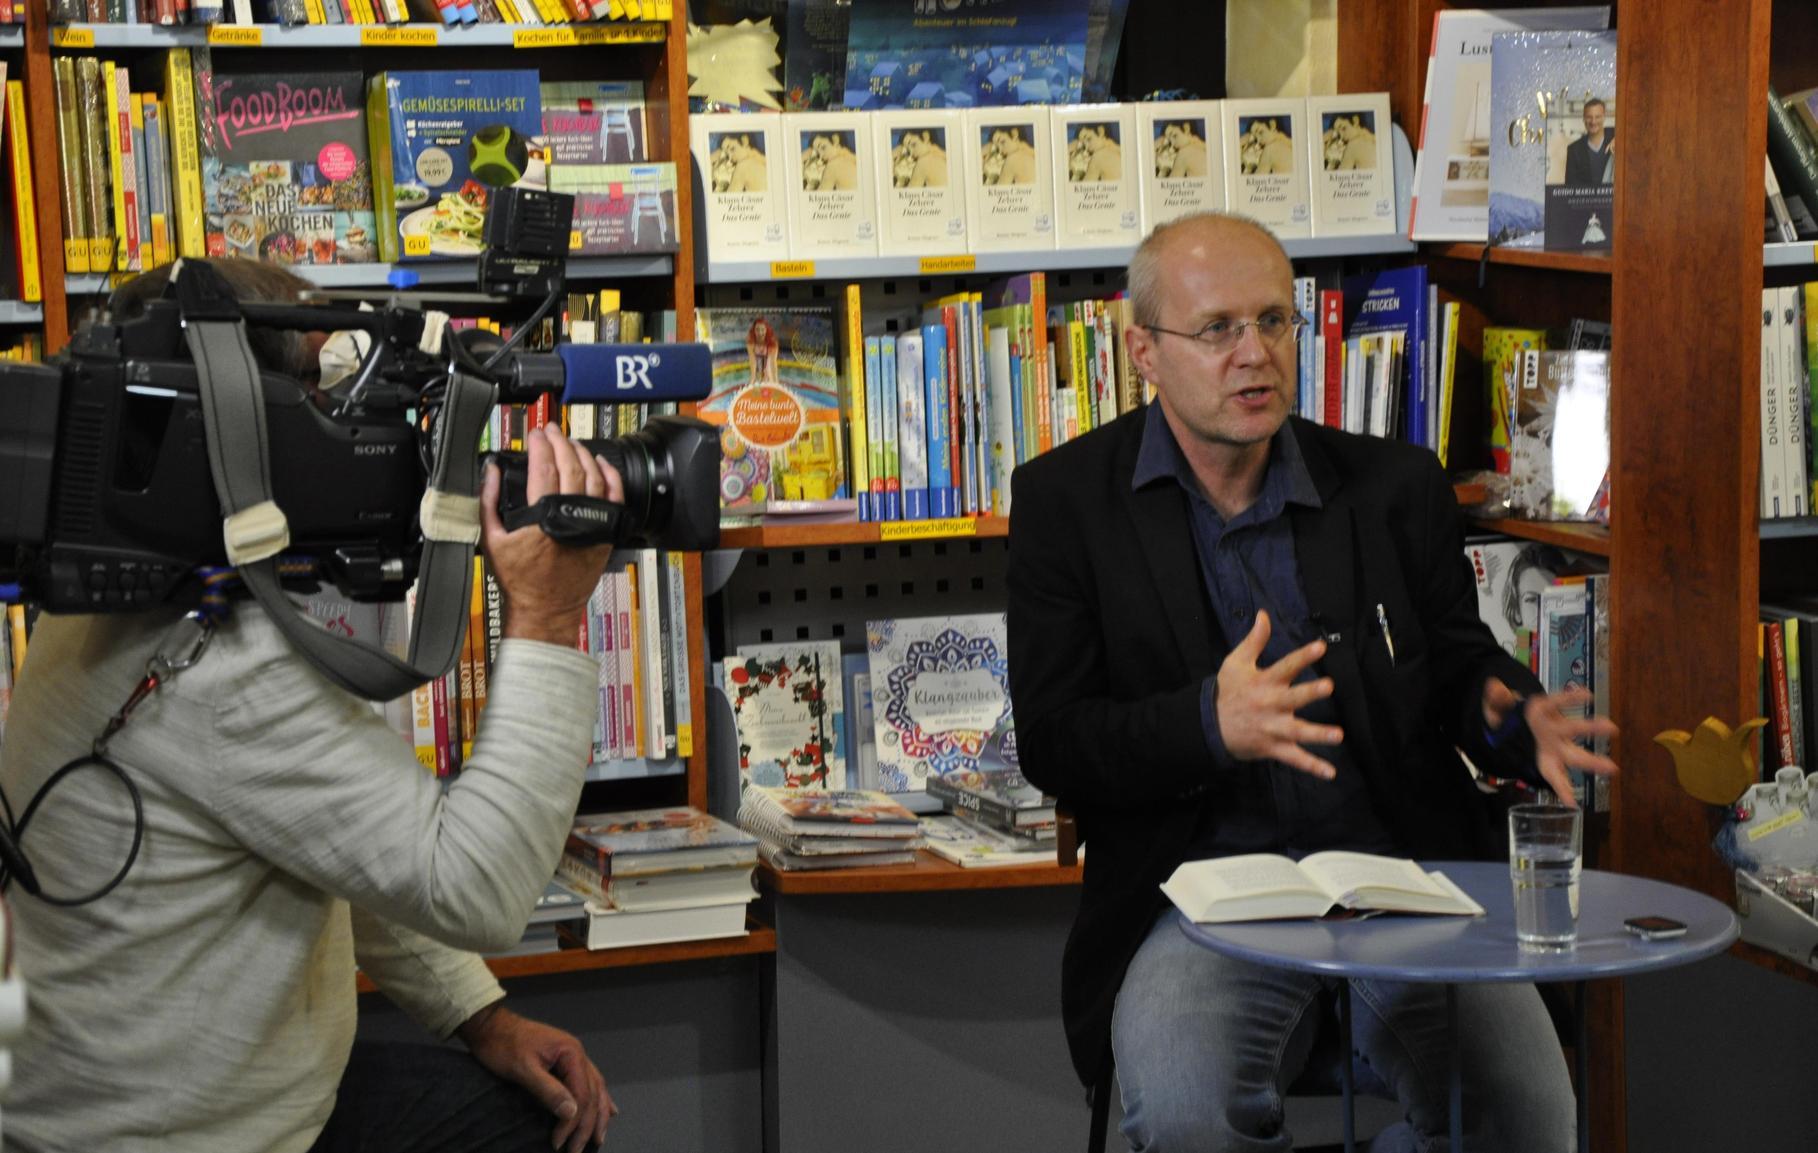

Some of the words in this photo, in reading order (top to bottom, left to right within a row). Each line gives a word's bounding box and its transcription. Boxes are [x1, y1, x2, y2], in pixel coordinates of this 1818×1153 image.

[59, 31, 86, 42] Wein
[212, 29, 258, 42] Getränke
[366, 31, 398, 42] Kinder
[401, 30, 435, 42] kochen
[517, 31, 553, 42] Kochen
[556, 30, 570, 42] für
[574, 29, 607, 41] Familie
[610, 28, 629, 39] und
[632, 27, 663, 38] Kinder
[265, 184, 298, 199] DAS
[255, 201, 297, 215] NEUE
[267, 215, 334, 231] KOCHEN
[408, 239, 426, 250] GU
[775, 262, 808, 274] Basteln
[921, 258, 976, 271] Handarbeiten
[1361, 297, 1400, 314] STRICKEN
[616, 354, 653, 390] BR
[737, 398, 768, 412] Meine
[736, 410, 800, 425] Bastelwelt
[1767, 388, 1778, 445] DÜNGER
[1788, 386, 1799, 443] DÜNGER
[354, 444, 397, 456] SONY
[560, 503, 608, 523] Canon
[881, 519, 976, 537] Kinderbeschäftigung
[460, 660, 472, 700] BROT
[474, 659, 486, 699] BROT
[915, 688, 997, 706] Klangzauber
